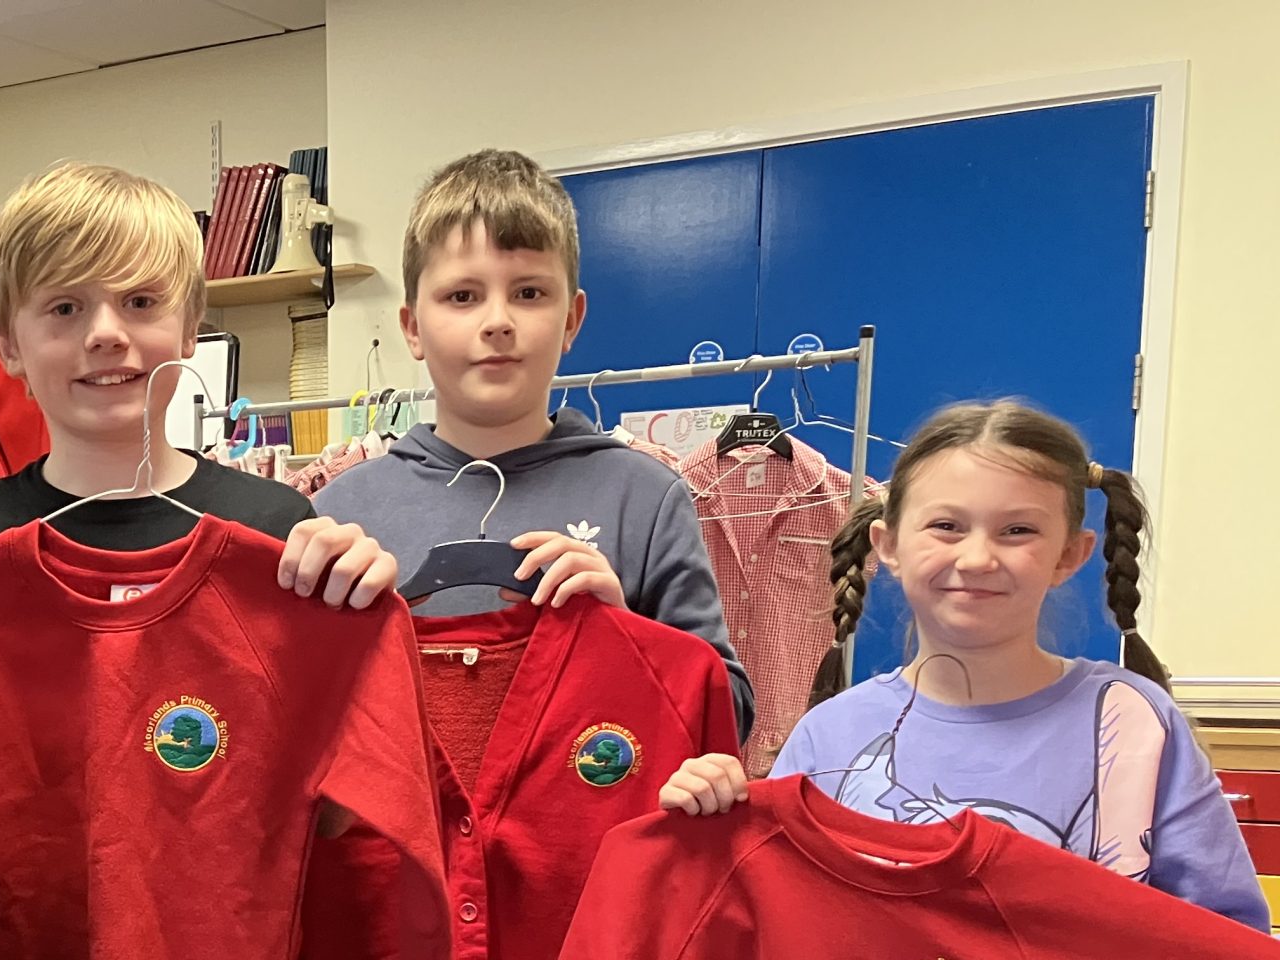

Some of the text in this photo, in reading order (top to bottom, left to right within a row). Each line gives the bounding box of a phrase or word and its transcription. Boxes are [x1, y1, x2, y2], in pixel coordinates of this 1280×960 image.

[736, 429, 776, 438] TRUTEX
[180, 695, 220, 718] Primary
[218, 720, 231, 759] School
